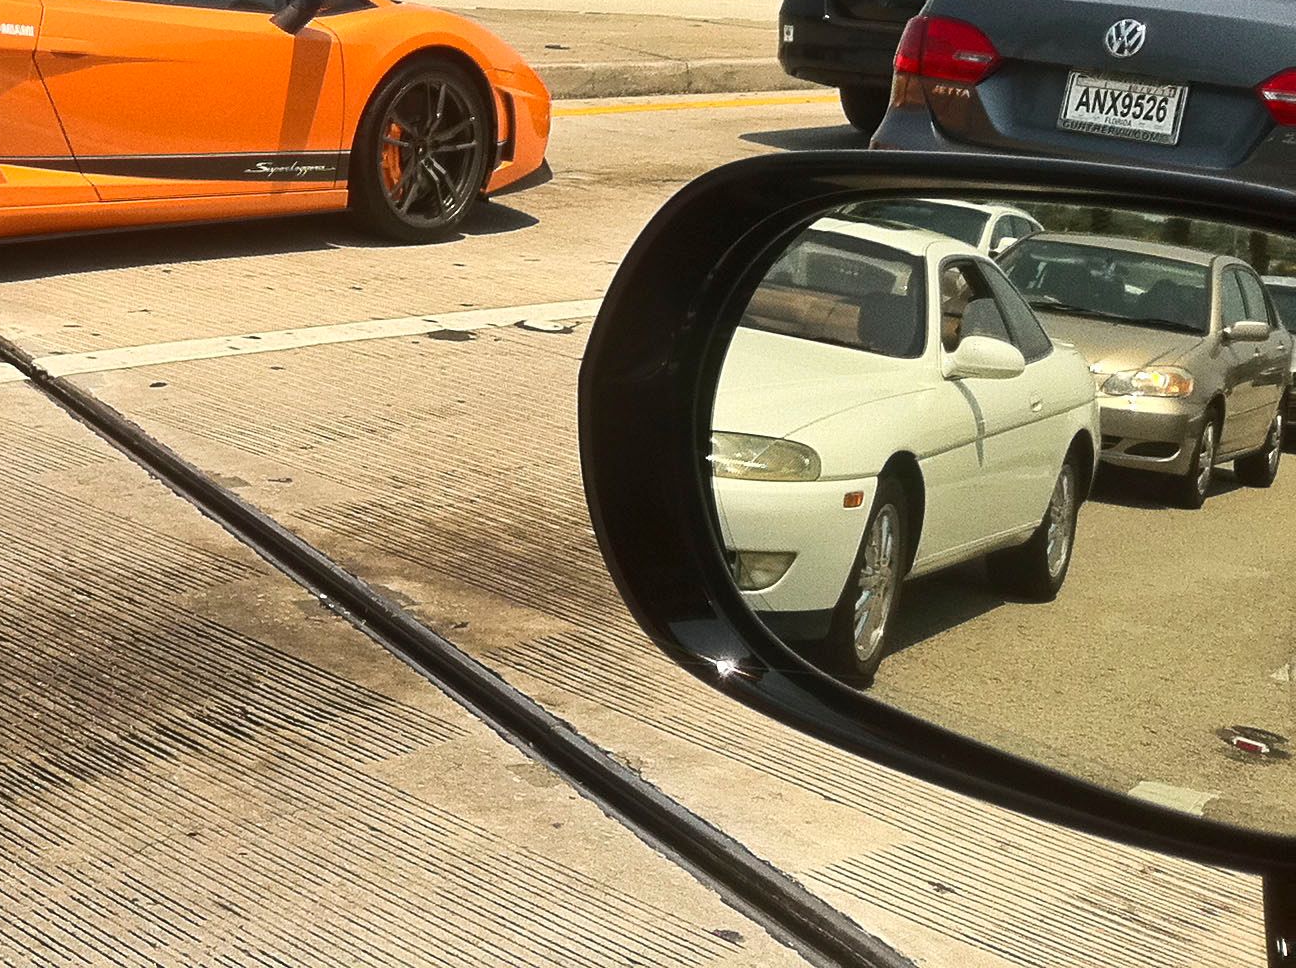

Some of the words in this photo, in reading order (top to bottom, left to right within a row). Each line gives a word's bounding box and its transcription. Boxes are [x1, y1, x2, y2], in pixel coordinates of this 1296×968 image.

[0, 23, 35, 37] MIAMI
[1074, 86, 1169, 123] ANX9526
[1104, 117, 1132, 128] FLORIDA
